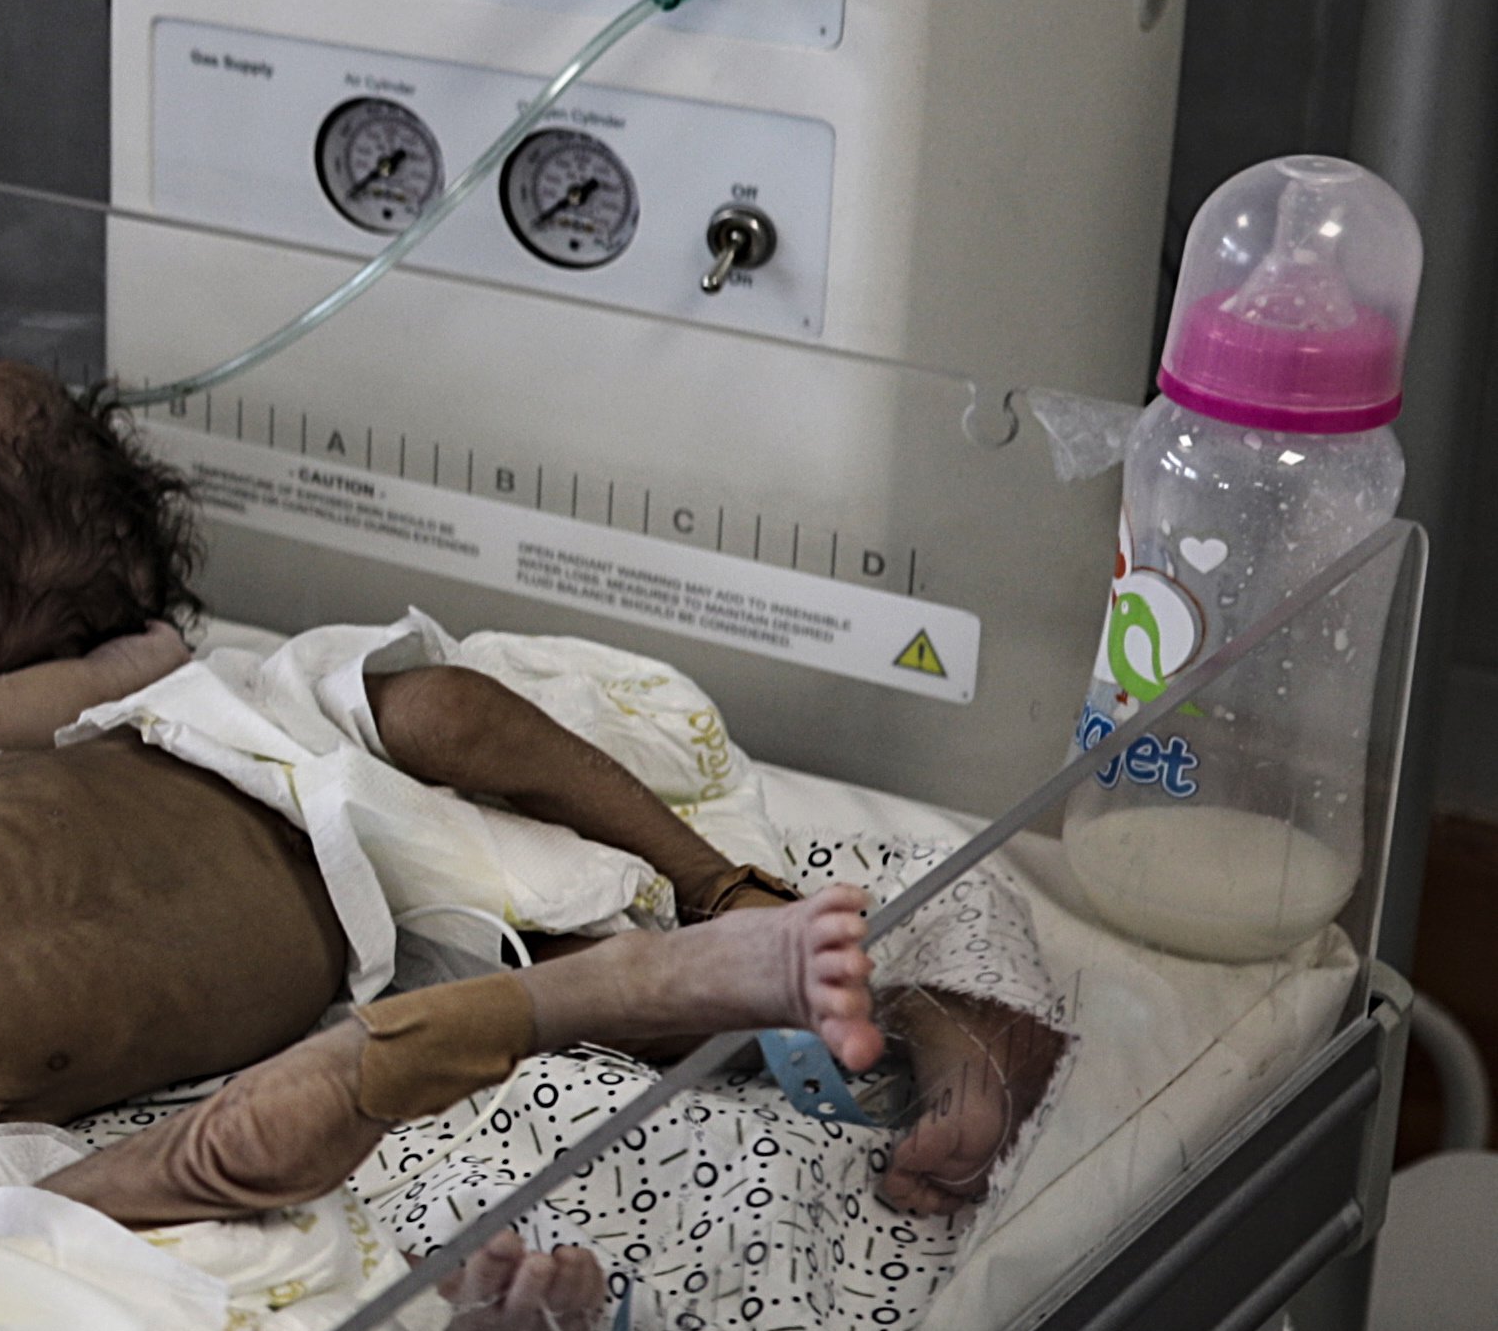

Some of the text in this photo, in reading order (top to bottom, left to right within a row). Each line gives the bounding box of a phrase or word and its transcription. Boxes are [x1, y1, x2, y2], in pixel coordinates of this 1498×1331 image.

[190, 47, 274, 81] Gas Supply
[517, 98, 569, 123] Ogen
[731, 181, 760, 202] Off
[326, 428, 347, 458] A
[299, 466, 375, 499] CAUTION
[495, 465, 516, 493] B
[438, 520, 455, 536] BE
[672, 507, 696, 536] C
[412, 529, 481, 558] EXTENDED
[861, 549, 886, 579] D
[517, 540, 852, 632] OPEN RADIANT WARMING MAY ADD TO INSENSIBLE
[517, 569, 554, 590] FLUID
[556, 579, 616, 605] BALANCE
[619, 595, 676, 619] SHOULD
[677, 608, 696, 625] BE
[517, 557, 562, 575] WATER
[606, 577, 680, 607] MEASURES
[684, 594, 703, 611] TO
[704, 600, 769, 627] MAINTAIN
[772, 617, 835, 644] DESIRED
